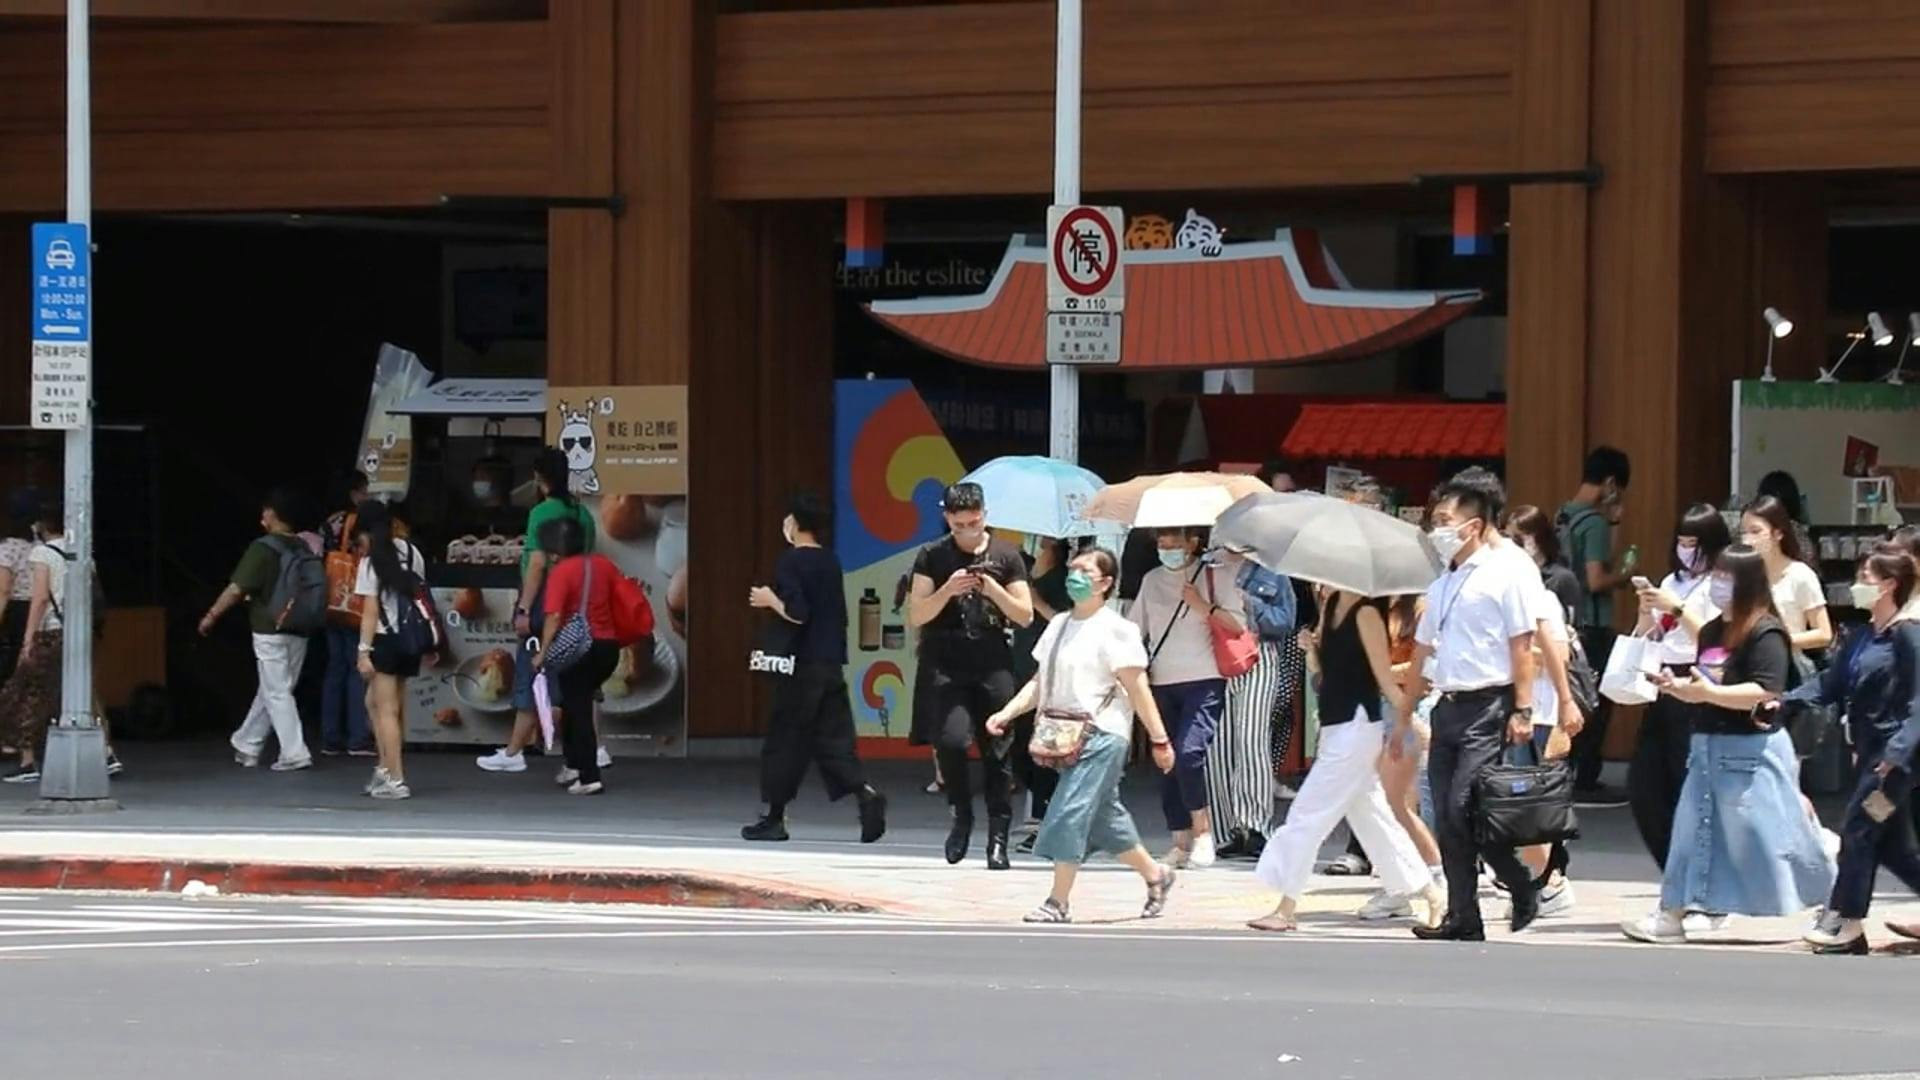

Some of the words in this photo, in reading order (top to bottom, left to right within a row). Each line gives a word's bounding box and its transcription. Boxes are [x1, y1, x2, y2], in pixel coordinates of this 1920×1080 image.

[1070, 230, 1102, 275] 停
[885, 261, 920, 286] the
[925, 261, 985, 286] eslite
[1086, 298, 1106, 310] 110
[59, 413, 77, 423] 110
